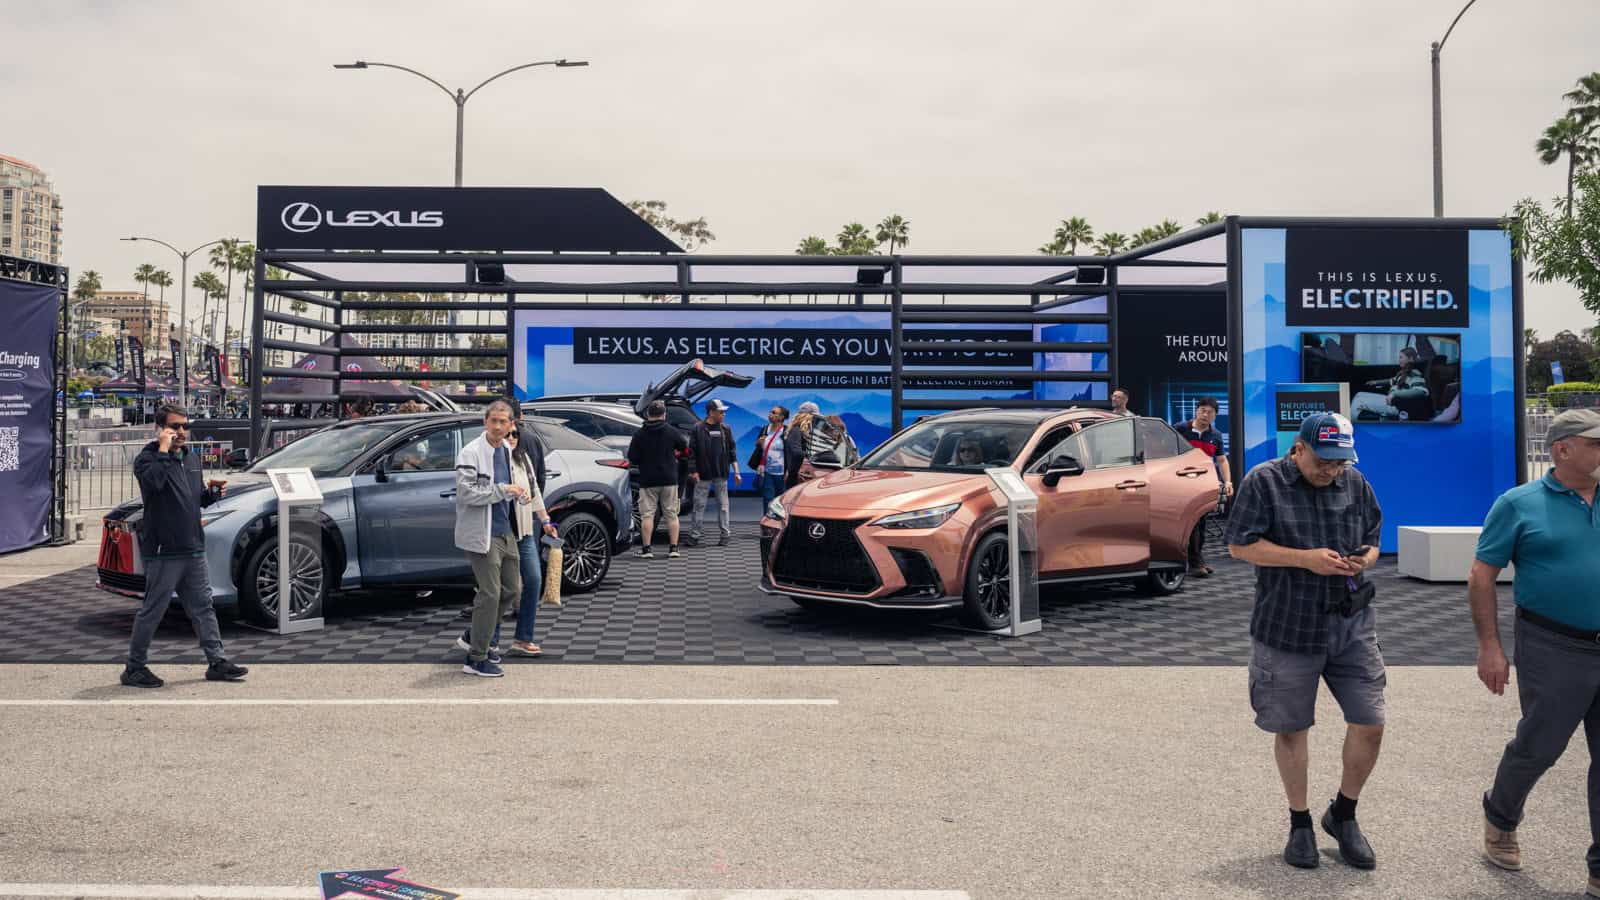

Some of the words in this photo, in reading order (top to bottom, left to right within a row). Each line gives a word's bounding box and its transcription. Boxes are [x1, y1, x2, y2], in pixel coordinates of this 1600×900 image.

[326, 210, 444, 227] LEXUS
[1318, 272, 1353, 282] THIS
[1362, 272, 1377, 282] IS
[1386, 272, 1443, 283] LEXUS.
[1302, 288, 1459, 310] ELECTRIFIED.
[588, 337, 659, 355] LEXUS.
[664, 337, 690, 355] AS
[696, 337, 795, 356] ELECTRIC
[800, 338, 826, 355] AS
[829, 338, 878, 356] YOU
[1165, 335, 1190, 347] THE
[0, 351, 40, 369] Charging
[774, 375, 813, 385] HYBRID
[821, 375, 863, 385] PLUG-IN
